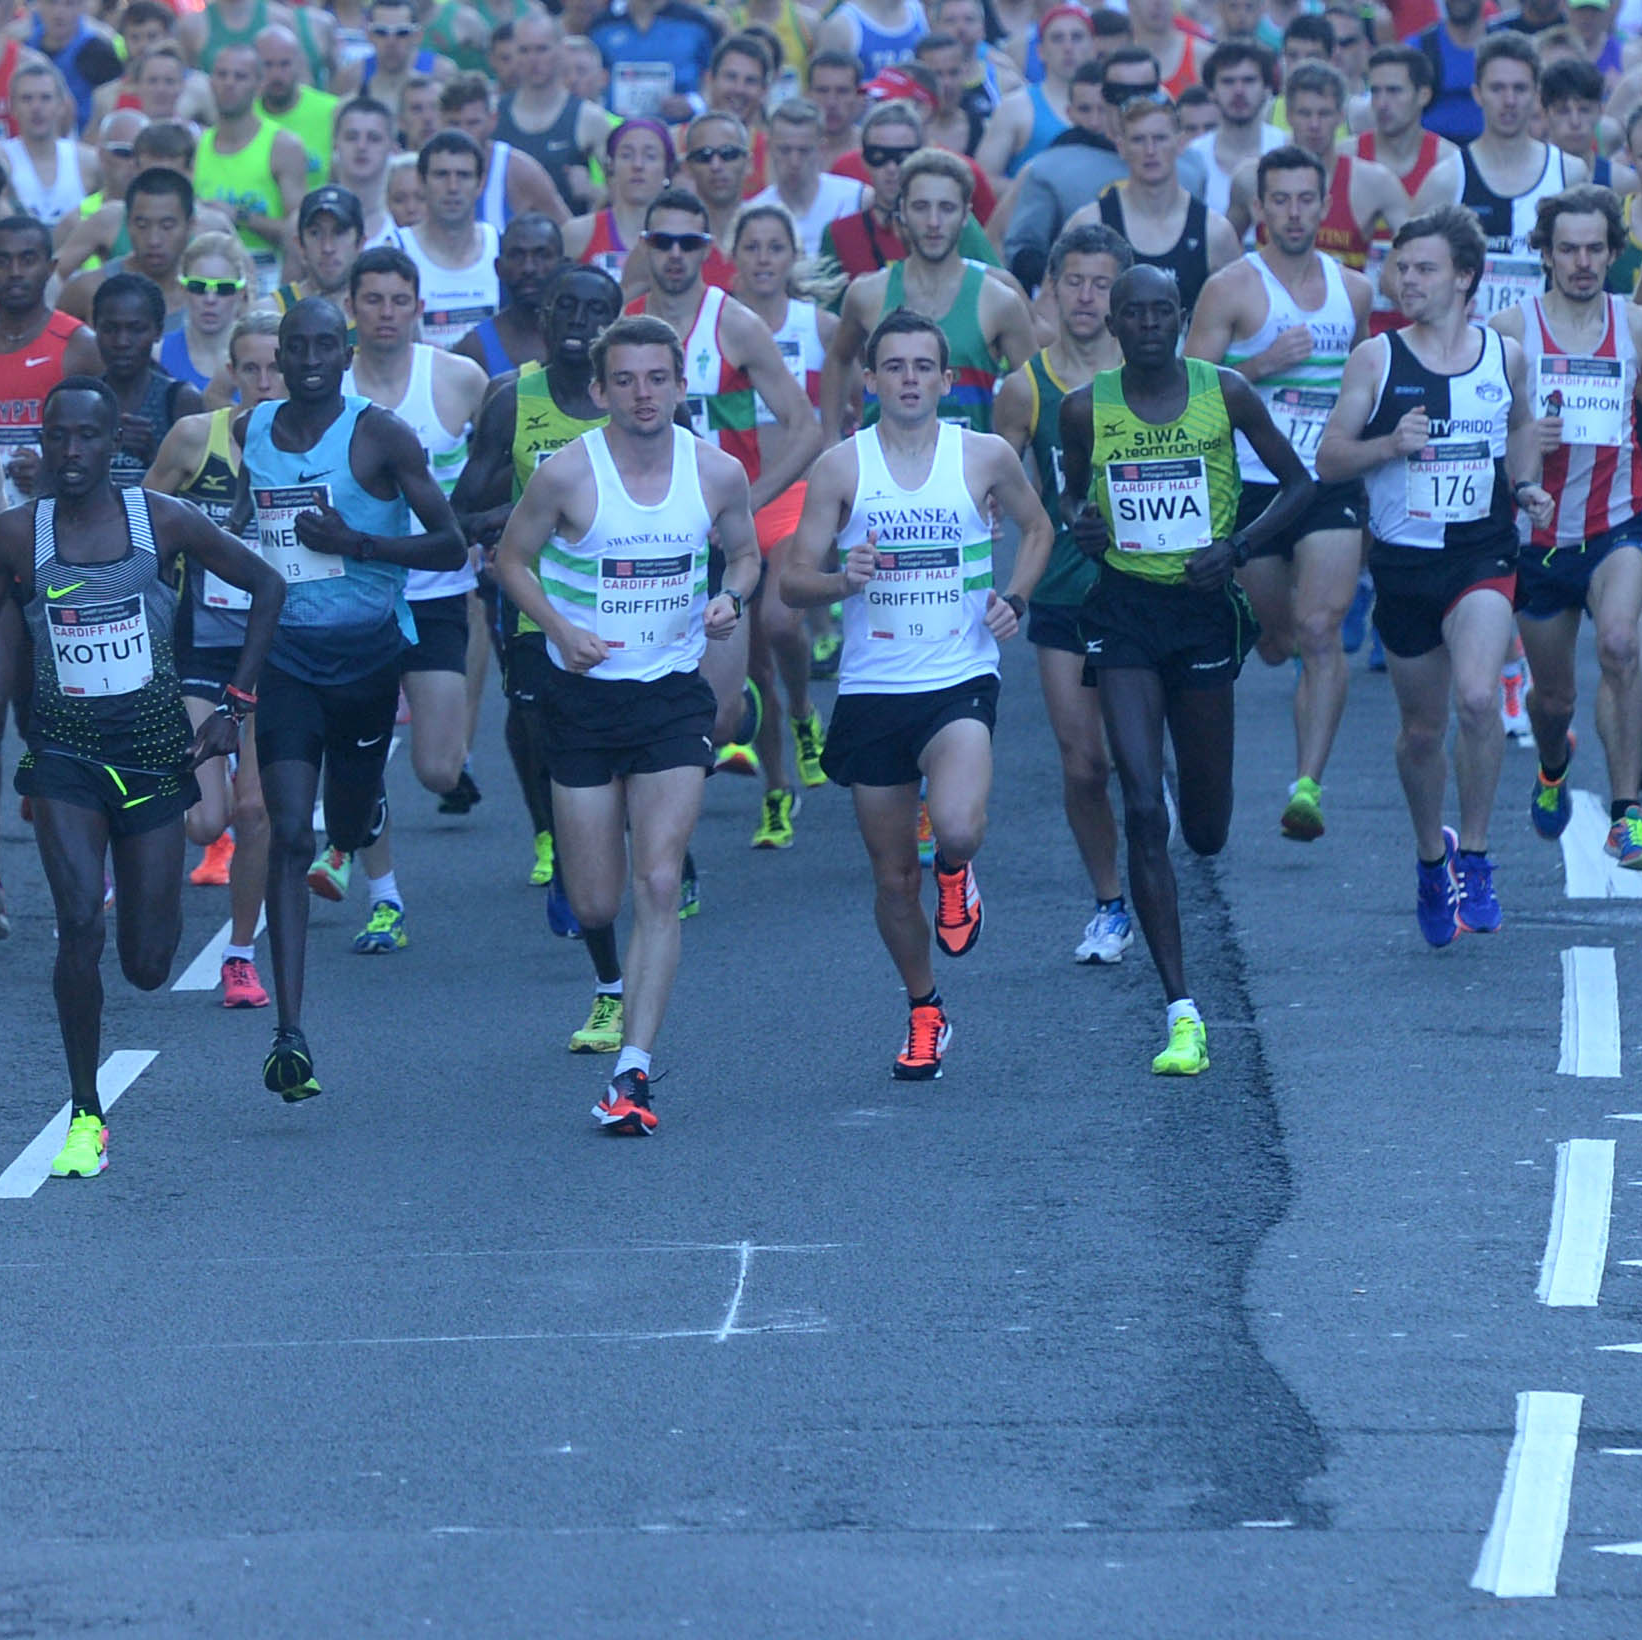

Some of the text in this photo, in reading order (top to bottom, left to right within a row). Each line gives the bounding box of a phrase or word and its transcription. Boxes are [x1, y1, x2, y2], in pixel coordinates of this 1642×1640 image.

[1134, 427, 1188, 446] SIWA
[1125, 445, 1164, 459] team
[1113, 479, 1202, 494] CARDIFF HALF
[1430, 475, 1476, 508] 176
[1118, 495, 1202, 522] SIWA
[867, 508, 960, 528] SWANSEA
[606, 533, 661, 548] SWANSEA
[1157, 533, 1166, 546] 5
[286, 563, 301, 577] 13
[925, 568, 959, 581] HALF
[603, 573, 690, 591] CARDIFF HALF
[601, 593, 690, 615] GRIFFITHS
[869, 589, 961, 606] GRIFFITHS
[53, 615, 141, 638] CARDIFF HALF
[908, 622, 924, 637] 19
[640, 631, 654, 644] 14
[56, 632, 145, 665] KOTUT
[101, 677, 109, 691] 1
